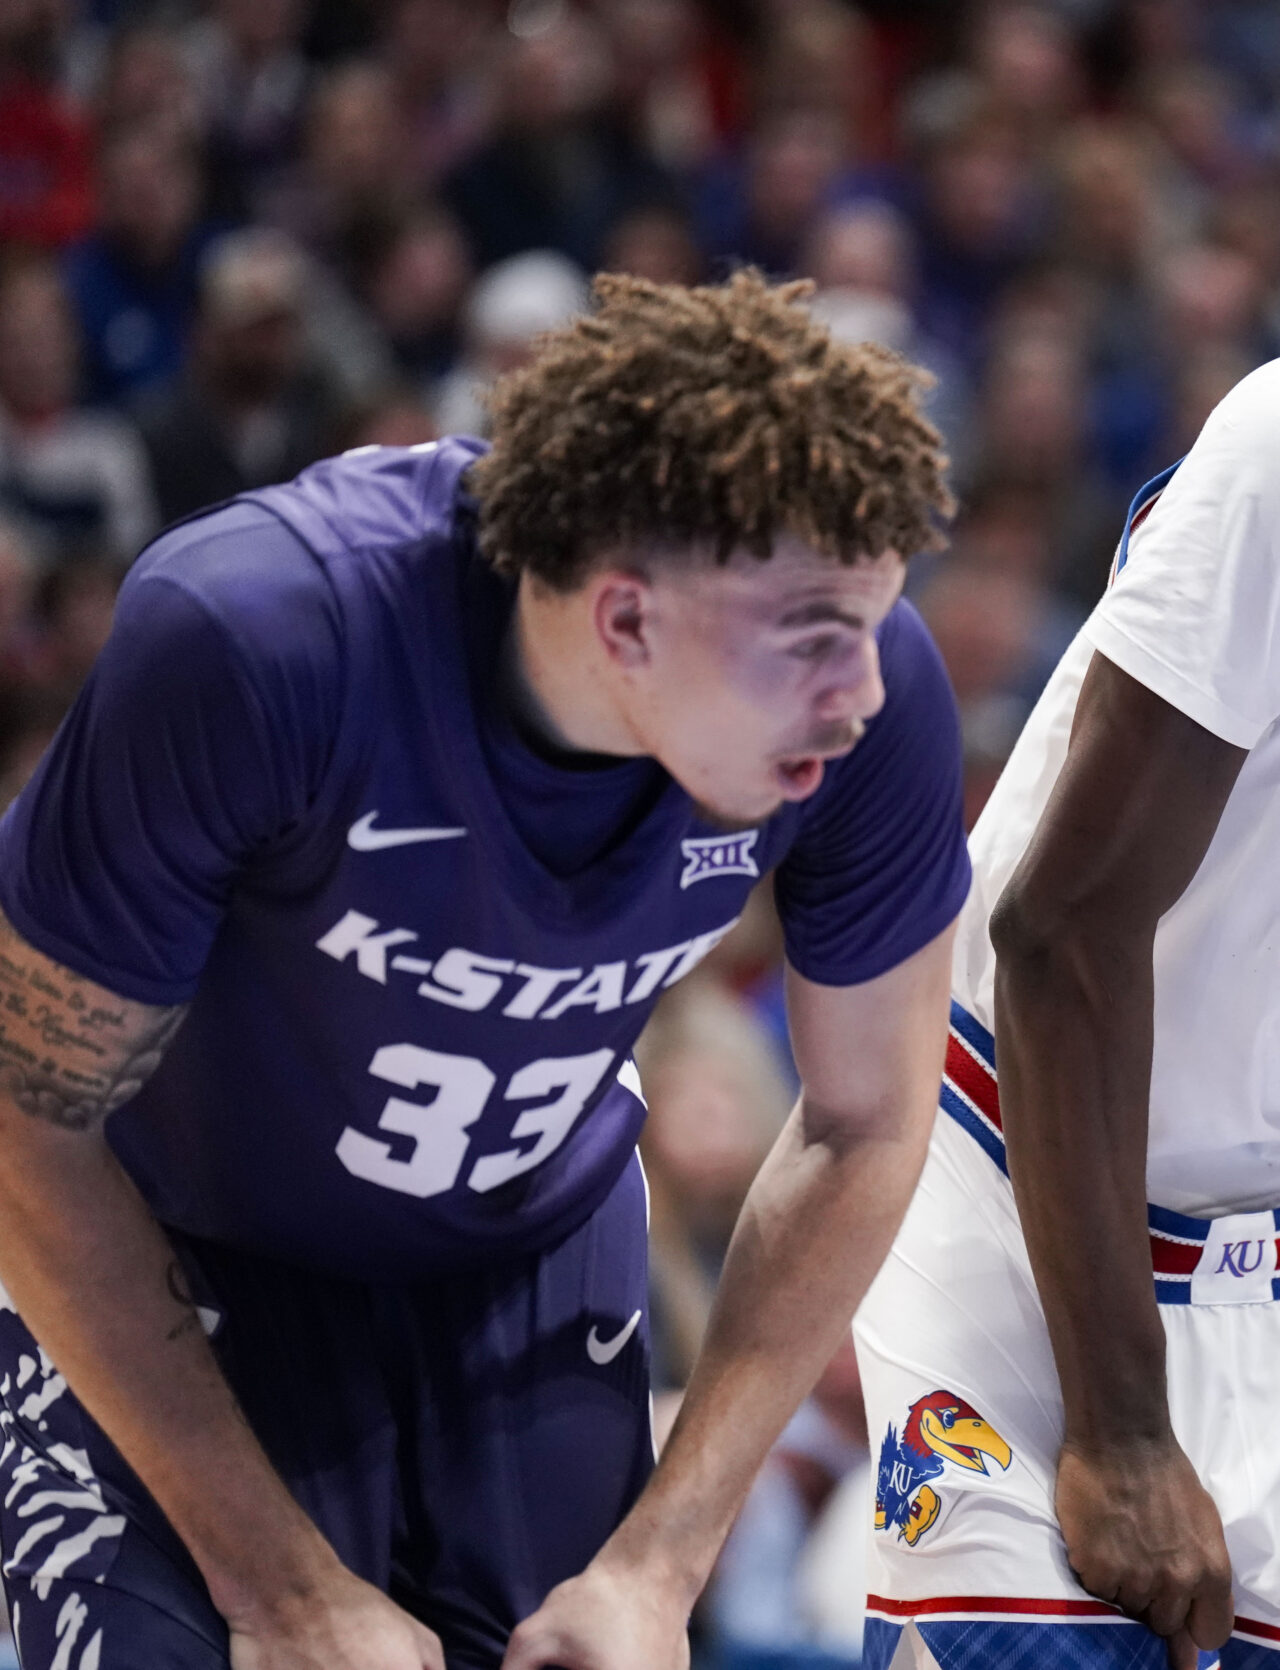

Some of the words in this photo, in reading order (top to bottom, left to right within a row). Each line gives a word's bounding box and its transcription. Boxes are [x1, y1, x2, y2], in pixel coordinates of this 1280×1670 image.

[680, 829, 760, 890] XII
[335, 1043, 615, 1198] 33
[1214, 1239, 1266, 1278] KU
[889, 1460, 914, 1497] KU
